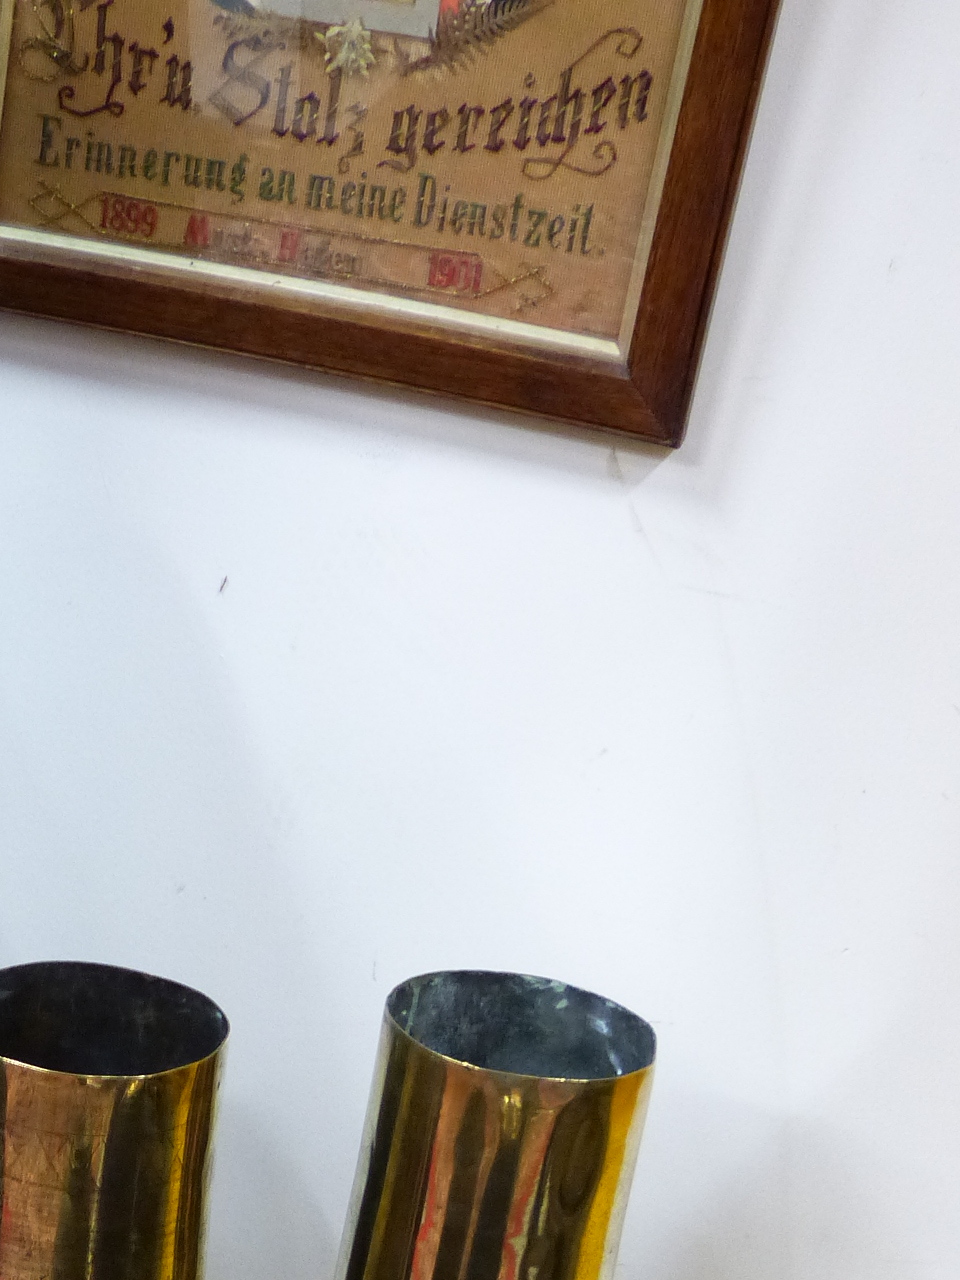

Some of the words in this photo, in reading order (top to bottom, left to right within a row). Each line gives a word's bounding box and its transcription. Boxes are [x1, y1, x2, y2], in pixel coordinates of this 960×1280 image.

[209, 34, 368, 174] Stolz
[377, 27, 652, 179] gereichen
[35, 113, 249, 203] Erinnerung
[259, 166, 296, 204] an
[304, 172, 407, 223] meine
[99, 195, 158, 238] 1899
[426, 252, 483, 293] 1901
